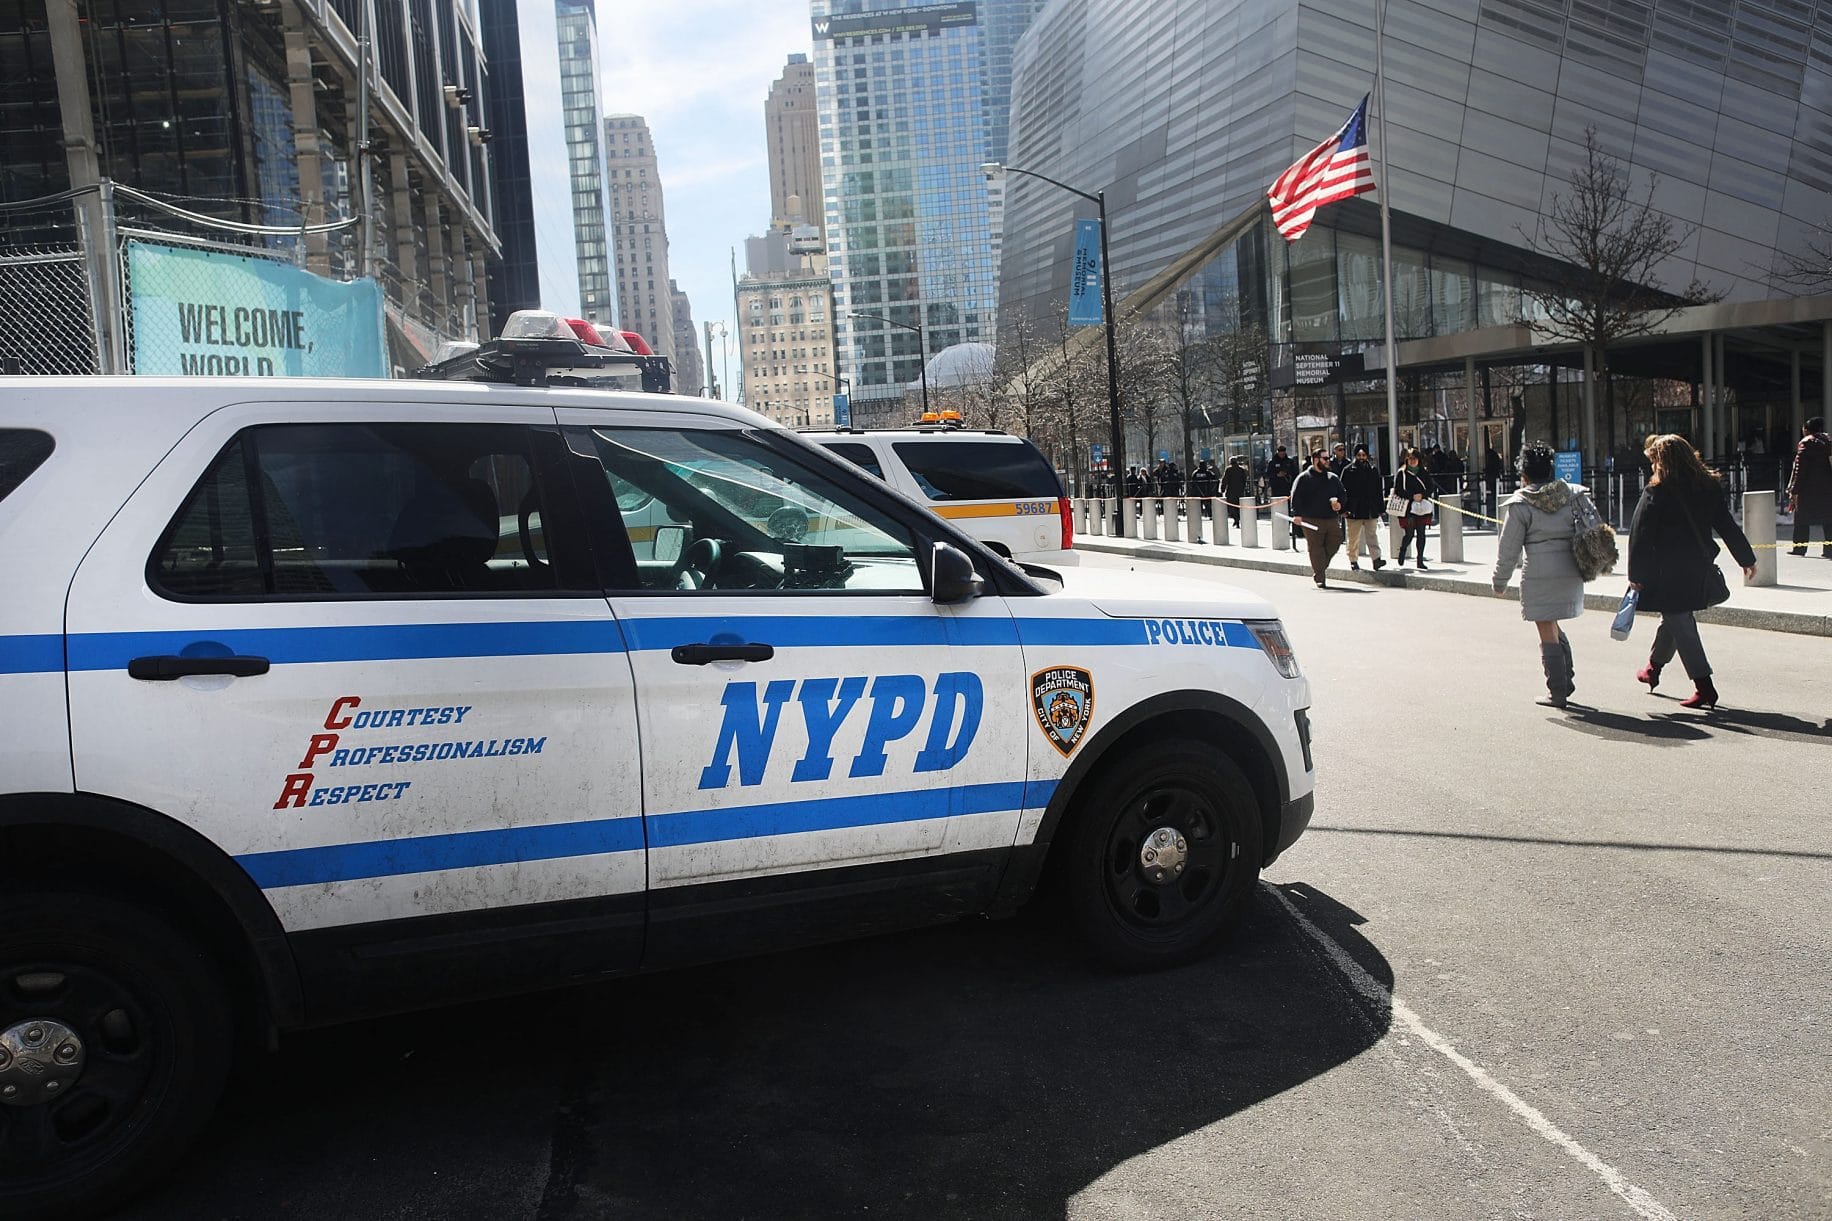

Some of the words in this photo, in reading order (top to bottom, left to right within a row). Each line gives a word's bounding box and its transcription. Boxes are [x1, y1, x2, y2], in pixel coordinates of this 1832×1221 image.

[814, 22, 830, 34] W
[1080, 248, 1088, 298] MEMORIAL
[178, 302, 314, 354] WELCOME,
[1295, 361, 1334, 369] SEPTEMBER
[1296, 369, 1331, 377] MEMORIAL
[1015, 502, 1052, 515] 59687
[1145, 619, 1226, 646] POLICE
[1035, 679, 1090, 698] DEPARTMENT
[1045, 670, 1077, 682] POLICE
[323, 696, 472, 730] COURTESY
[1037, 707, 1051, 729] CITY
[1049, 731, 1060, 742] OF
[1070, 726, 1084, 744] NEW
[1081, 698, 1091, 722] YORK
[698, 671, 984, 790] NYPD
[298, 733, 547, 769] PROFESSIONALISM
[272, 773, 412, 810] RESPECT
